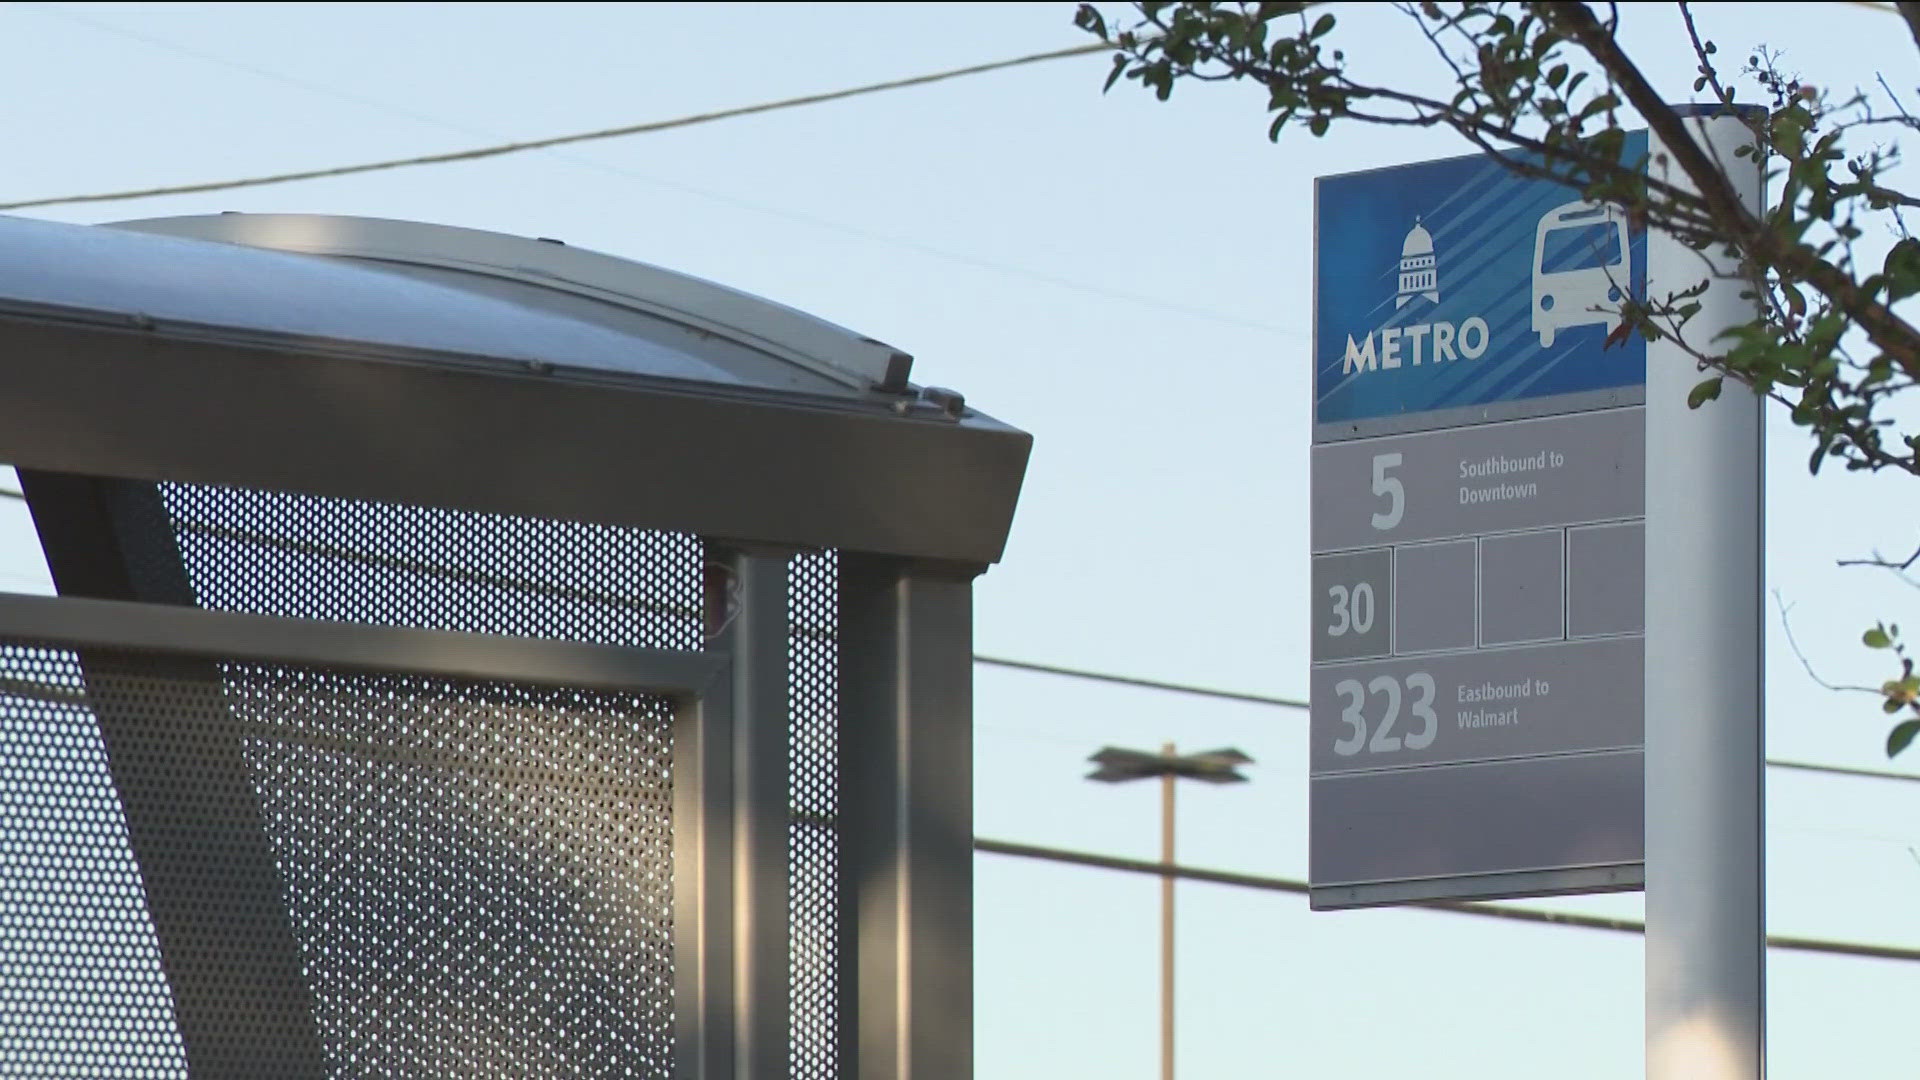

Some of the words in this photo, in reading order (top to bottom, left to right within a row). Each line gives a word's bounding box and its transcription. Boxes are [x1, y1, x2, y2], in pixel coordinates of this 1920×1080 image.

[1342, 316, 1490, 375] METRO
[1459, 451, 1545, 478] Southbound
[1549, 451, 1564, 469] to
[1371, 452, 1405, 530] 5
[1459, 481, 1537, 505] Downtown
[1327, 582, 1375, 637] 30
[1457, 678, 1531, 703] Eastbound
[1535, 679, 1550, 696] to
[1333, 672, 1438, 756] 323
[1457, 706, 1519, 730] Walmart
